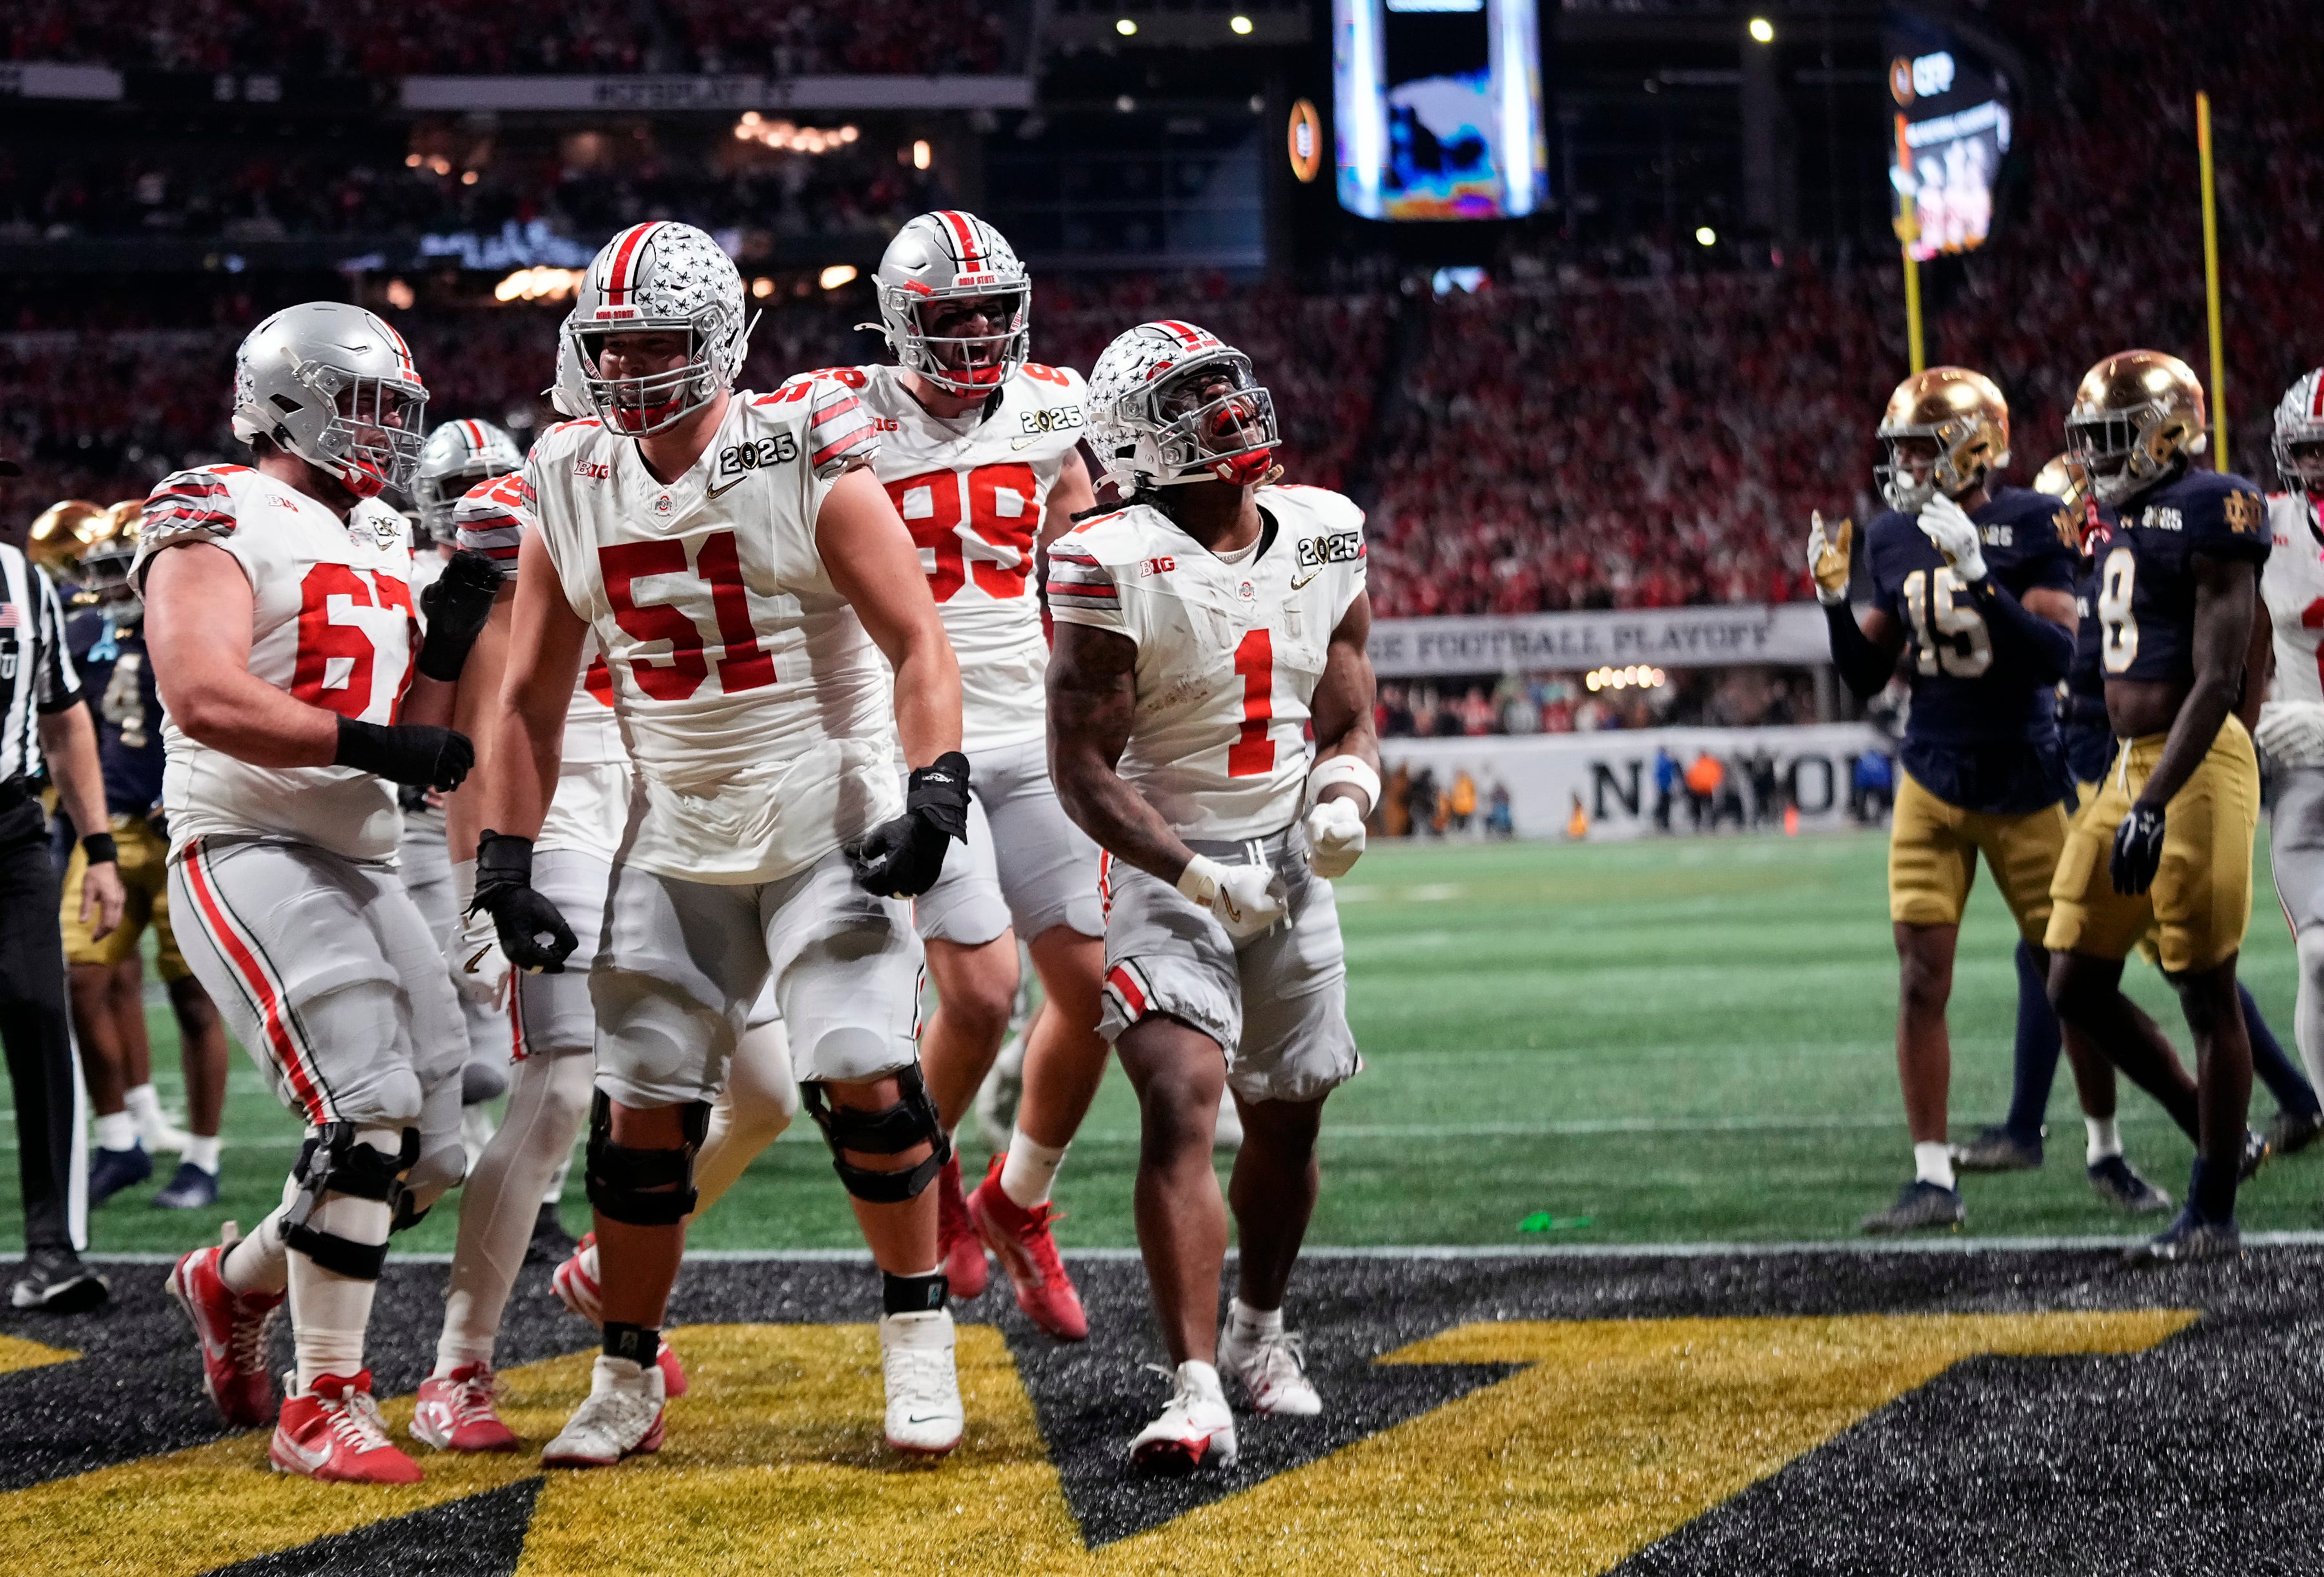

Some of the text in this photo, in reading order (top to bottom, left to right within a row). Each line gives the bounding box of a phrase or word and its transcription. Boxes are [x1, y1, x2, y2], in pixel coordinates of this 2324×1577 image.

[720, 431, 798, 476] 2025
[1020, 405, 1085, 433] 2025
[574, 459, 609, 480] BIG
[882, 461, 1041, 603] 89
[1139, 556, 1176, 578] BIG
[1298, 531, 1361, 567] 2025
[290, 562, 425, 726] 67
[598, 531, 778, 701] 51
[1418, 624, 1602, 660] FOOTBALL
[1613, 618, 1771, 652] PLAYOFF
[1903, 565, 1993, 678] 15
[2098, 547, 2139, 674] 8
[1228, 628, 1276, 778] 1
